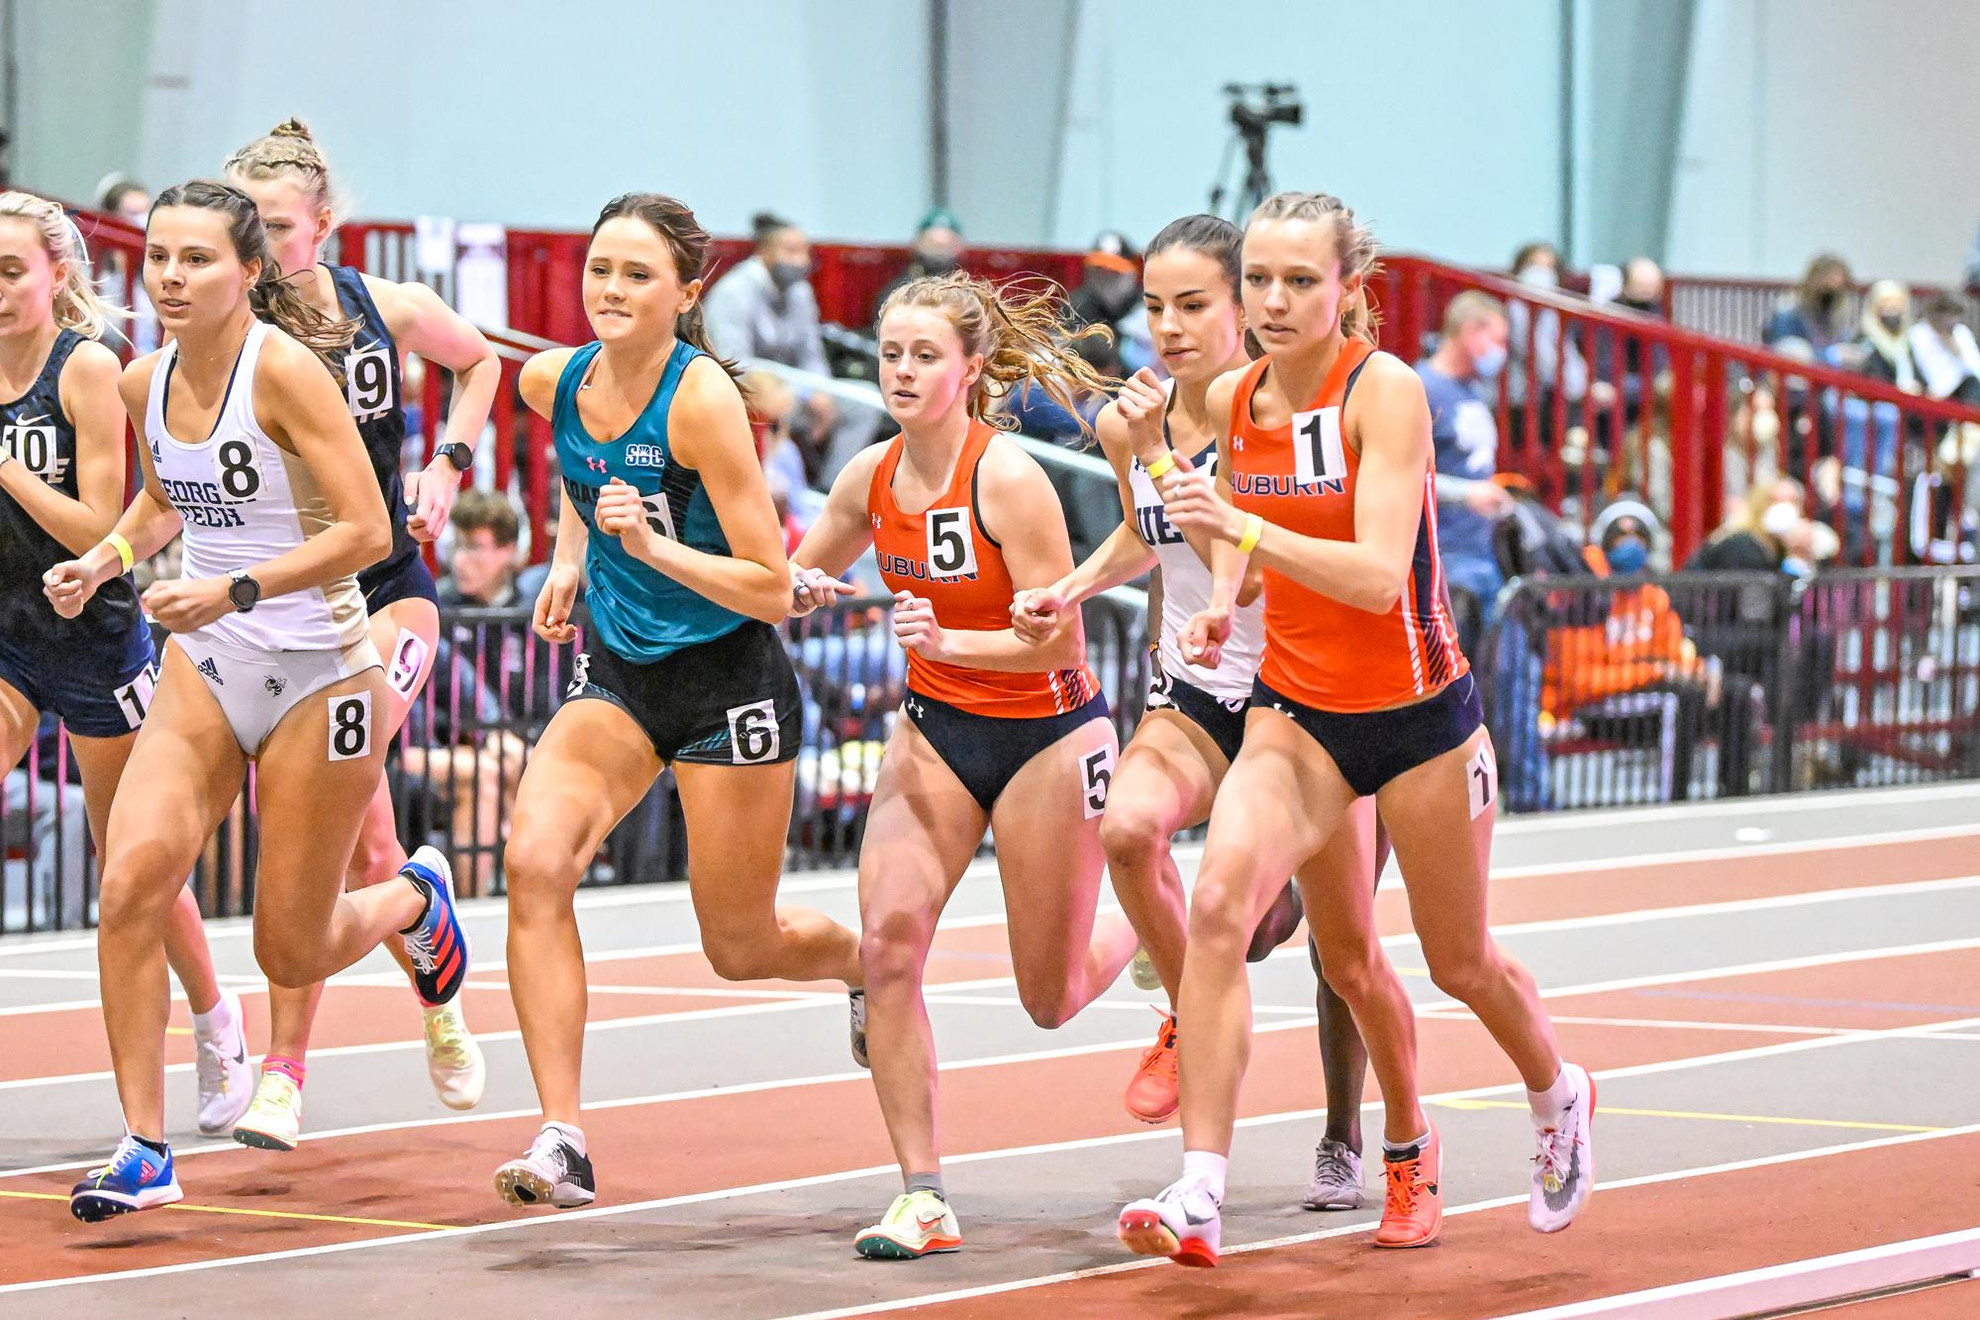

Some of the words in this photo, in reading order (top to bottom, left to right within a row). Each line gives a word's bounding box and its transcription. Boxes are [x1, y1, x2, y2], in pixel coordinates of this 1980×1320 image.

[354, 355, 388, 410] 9
[5, 428, 48, 473] 10
[218, 440, 260, 498] 8
[625, 443, 666, 468] SBC
[1300, 413, 1327, 477] 1
[160, 477, 257, 506] EORG
[175, 504, 245, 528] TECH
[932, 511, 966, 572] 5
[333, 698, 366, 757] 8
[736, 707, 774, 762] 6
[1086, 749, 1112, 811] 5
